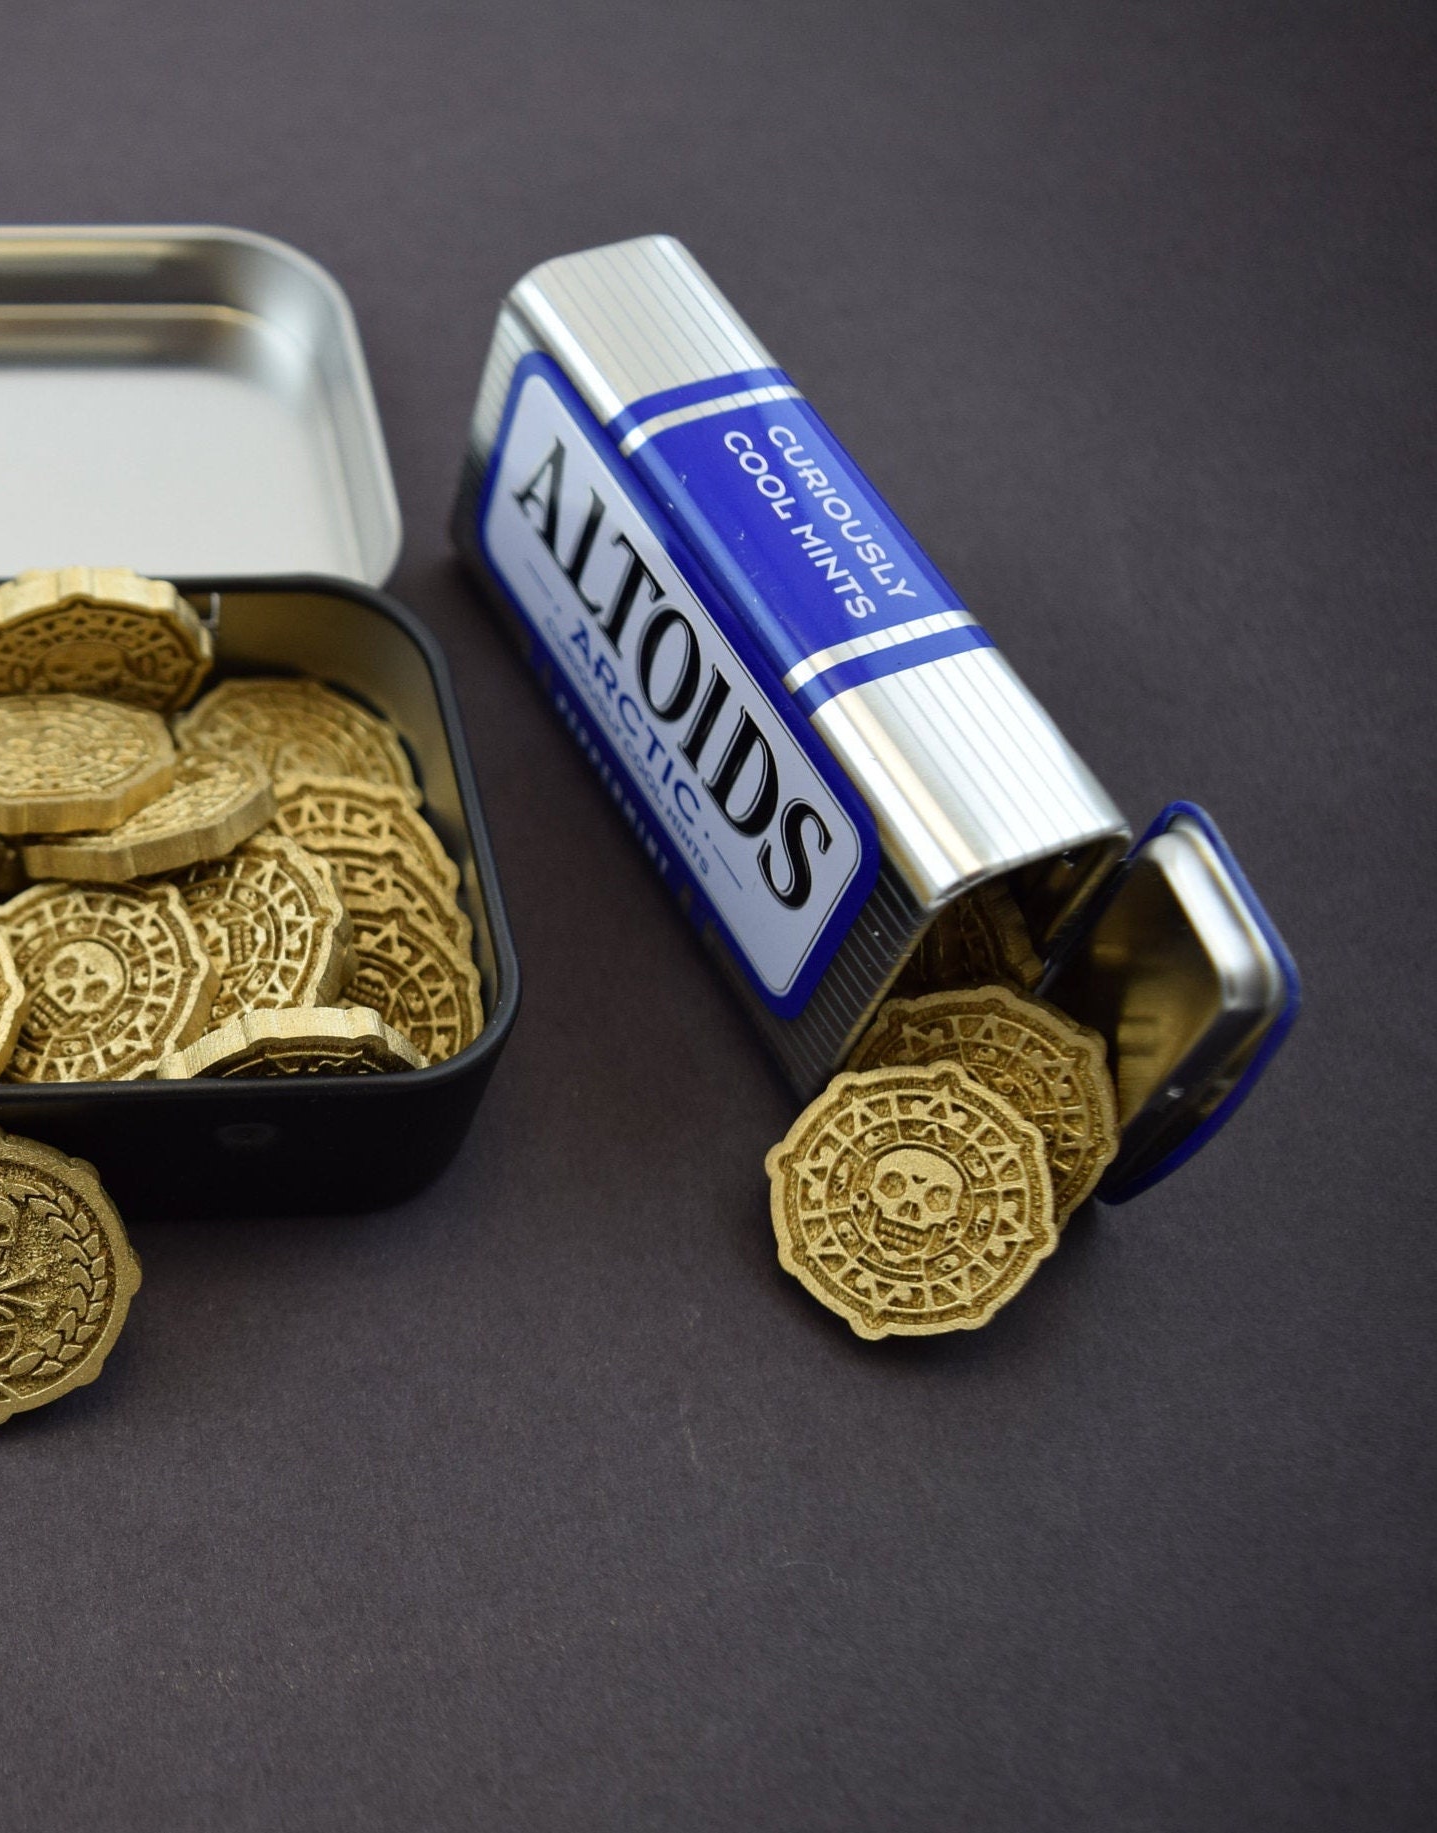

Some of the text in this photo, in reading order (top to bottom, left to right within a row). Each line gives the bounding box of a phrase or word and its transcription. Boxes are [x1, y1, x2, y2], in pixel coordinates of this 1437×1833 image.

[723, 431, 877, 619] COOL MINTS
[768, 425, 917, 598] CURIOUSLY
[513, 435, 833, 911] ALTOIDS
[570, 618, 701, 827] ARCTIC
